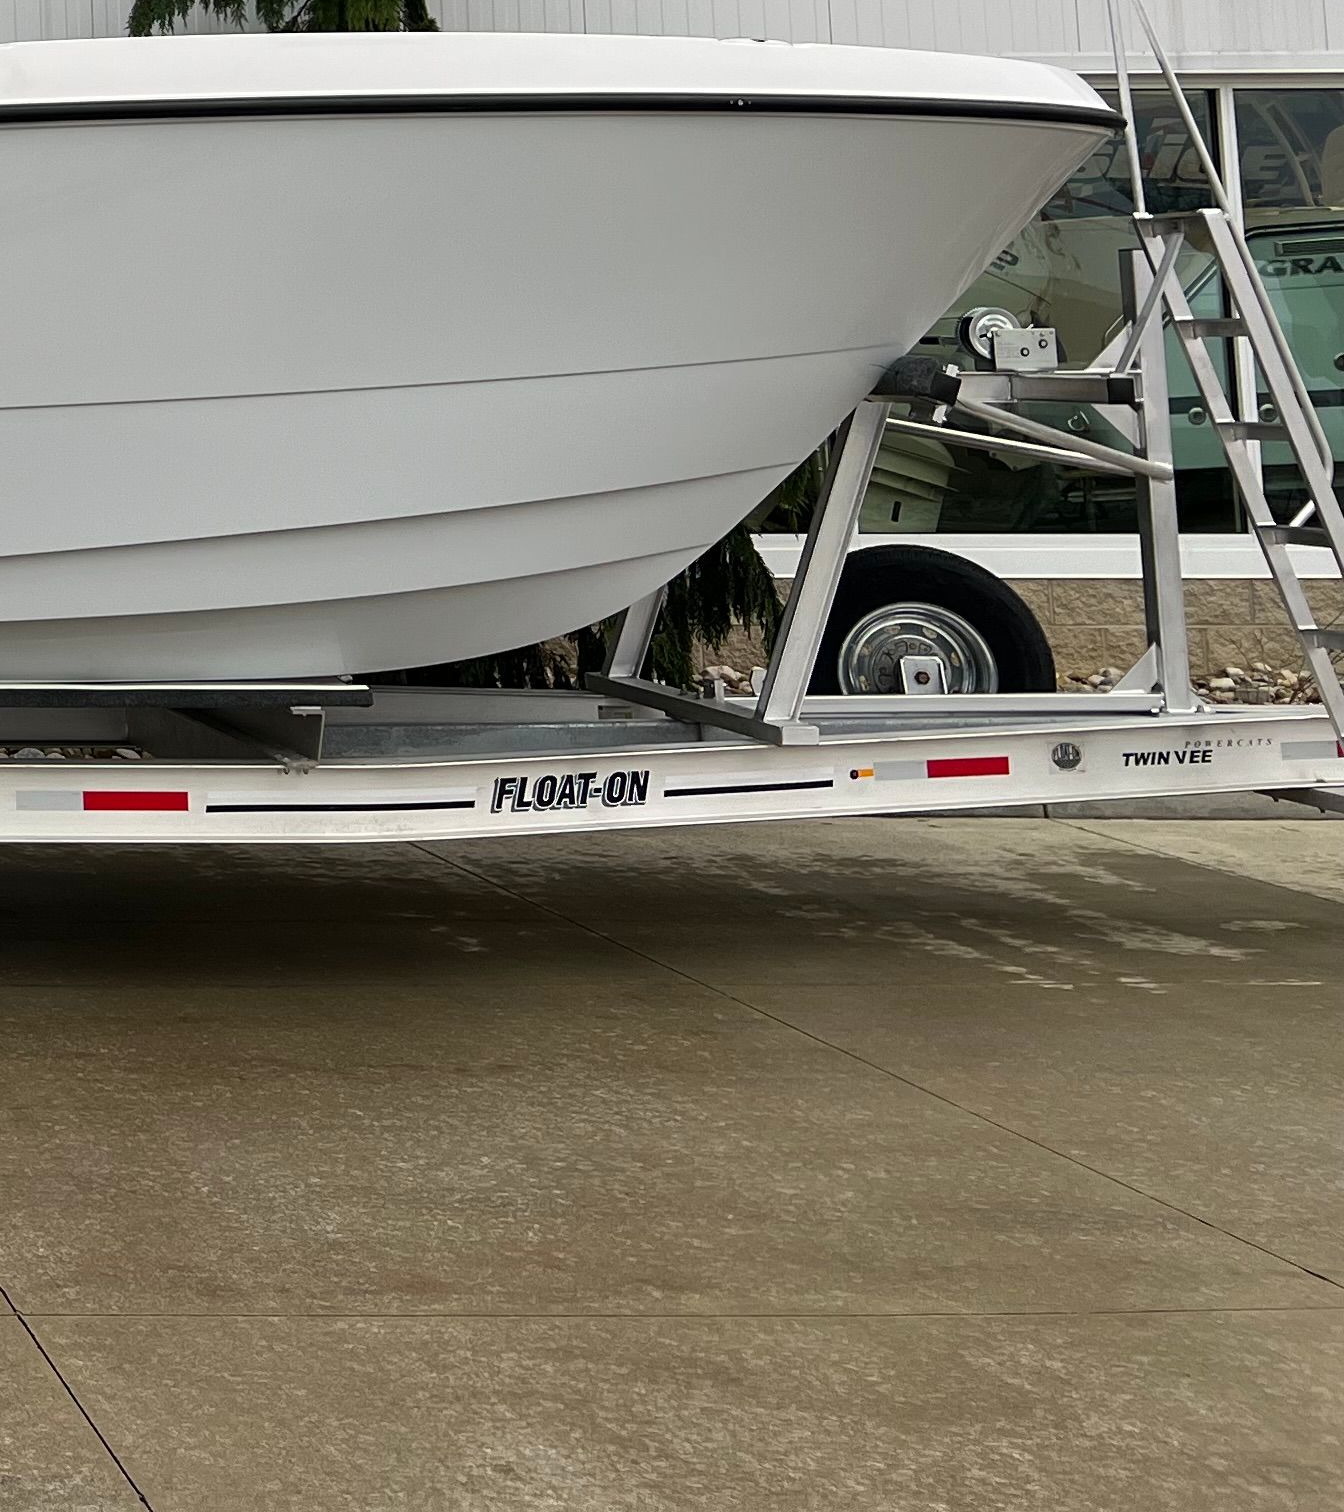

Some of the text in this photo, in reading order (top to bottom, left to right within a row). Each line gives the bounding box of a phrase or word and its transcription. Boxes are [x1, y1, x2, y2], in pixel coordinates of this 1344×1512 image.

[1121, 749, 1214, 767] TWIN VEE
[491, 770, 650, 813] FLOAT-ON
